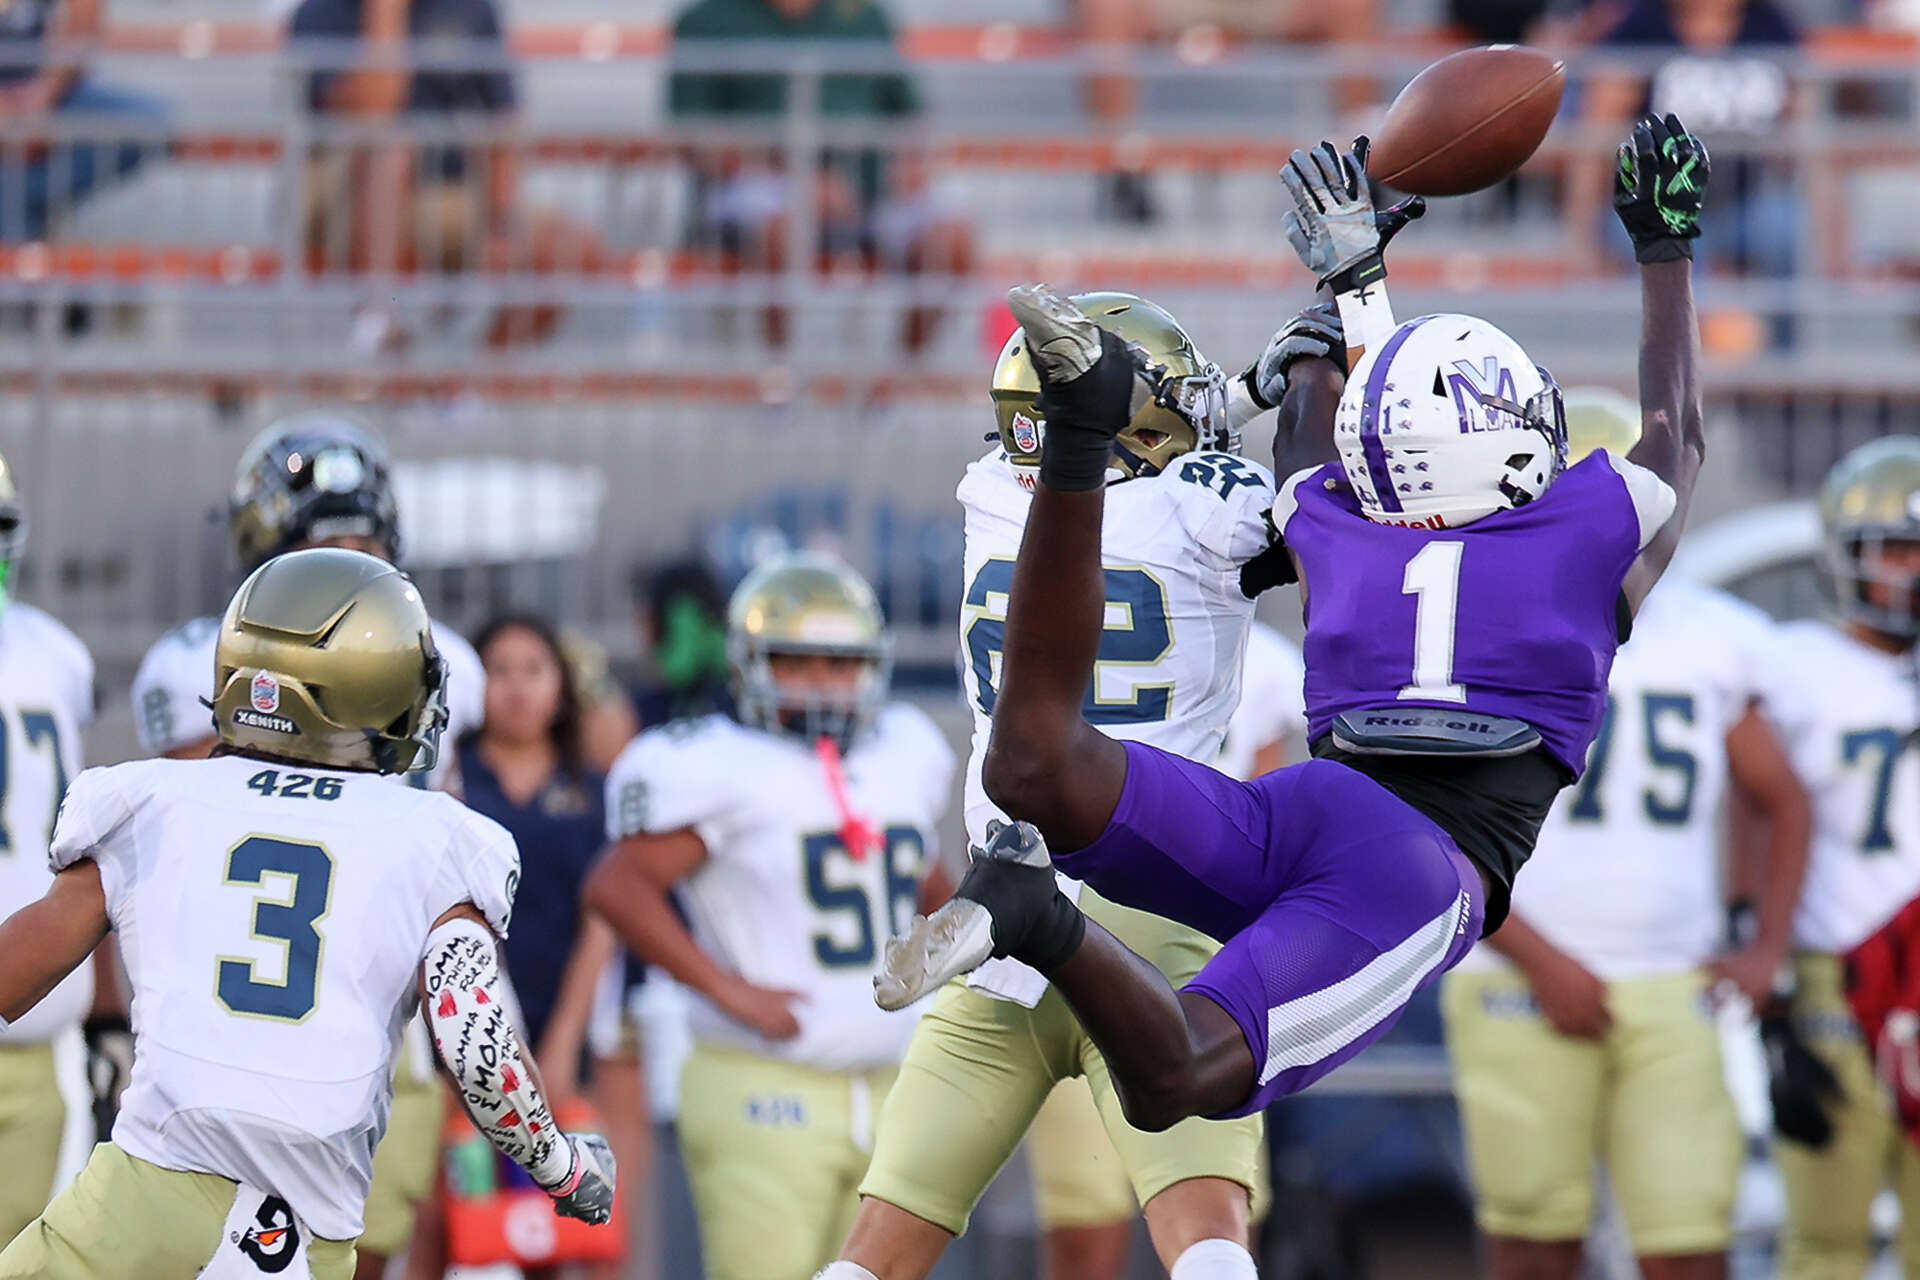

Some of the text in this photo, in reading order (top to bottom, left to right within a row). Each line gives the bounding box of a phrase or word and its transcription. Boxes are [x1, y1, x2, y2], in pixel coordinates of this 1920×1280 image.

[1381, 404, 1393, 435] 1
[1396, 540, 1467, 704] 1
[237, 710, 294, 732] XENITH
[0, 708, 68, 856] 7
[247, 769, 346, 801] 426
[212, 832, 338, 1026] 3
[426, 936, 469, 999] OMM
[463, 1089, 501, 1112] MO
